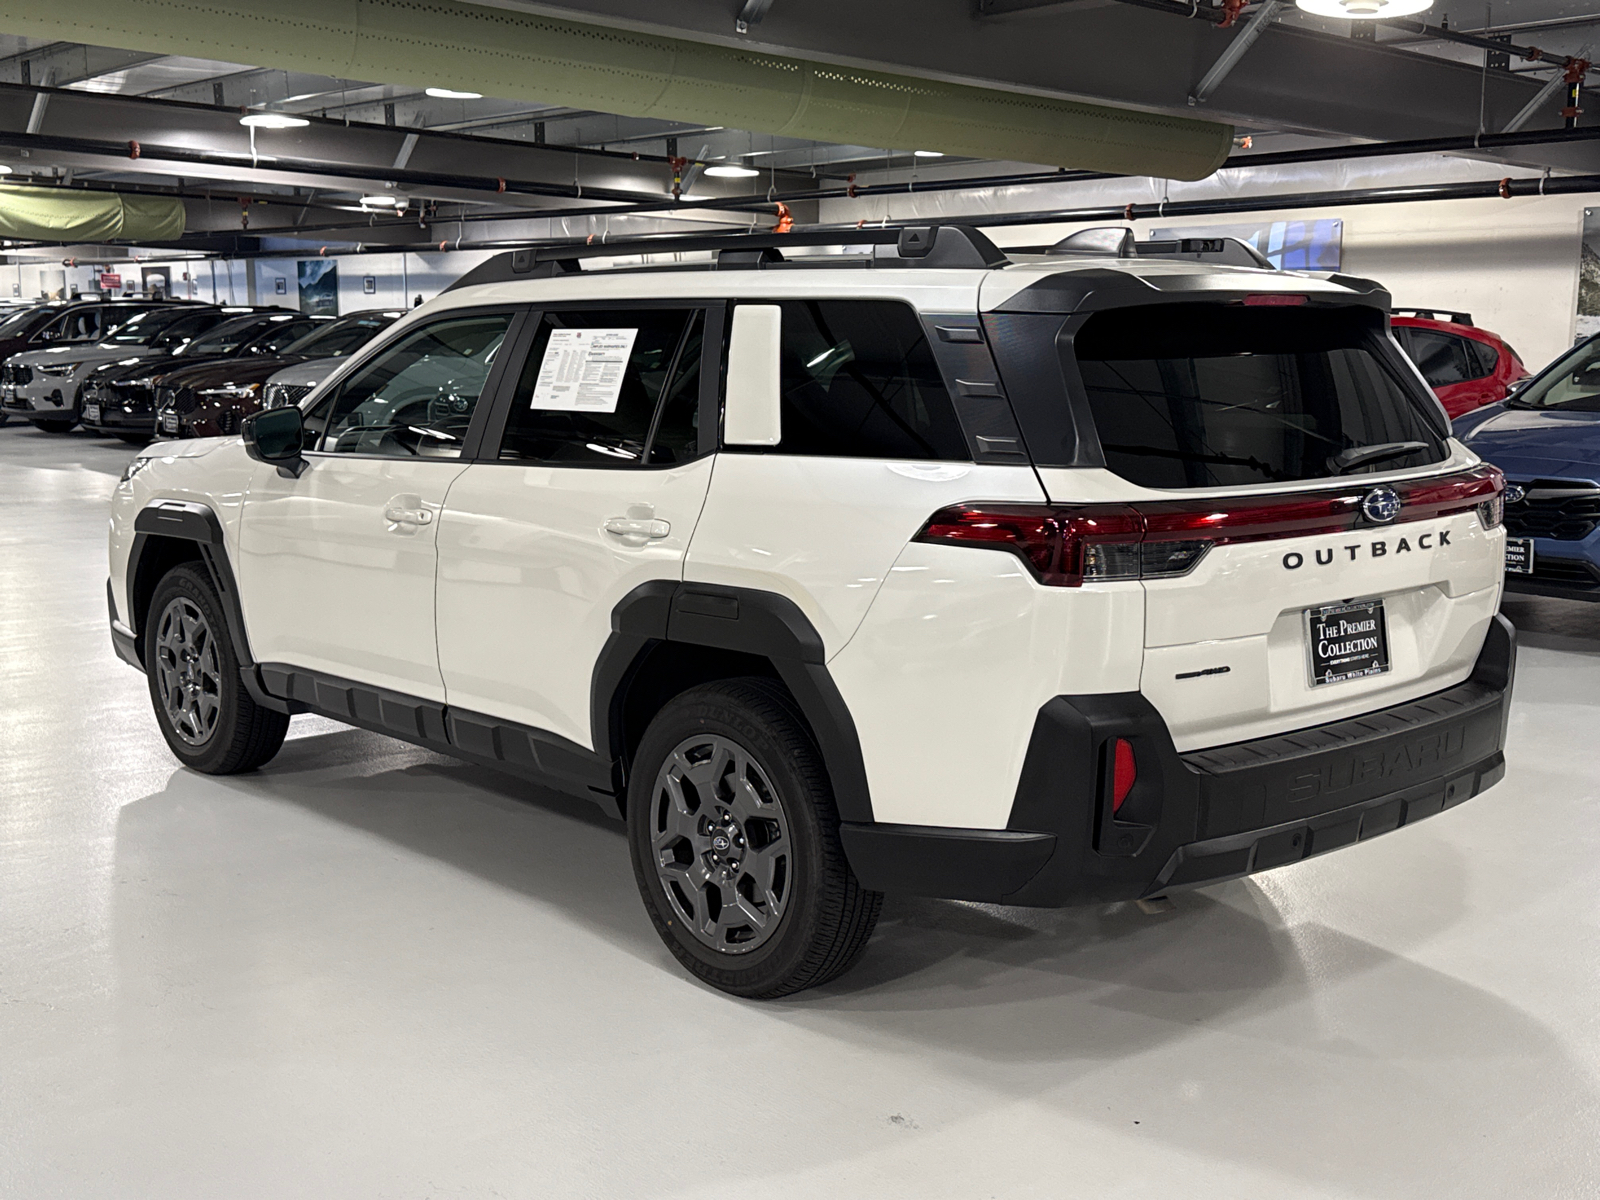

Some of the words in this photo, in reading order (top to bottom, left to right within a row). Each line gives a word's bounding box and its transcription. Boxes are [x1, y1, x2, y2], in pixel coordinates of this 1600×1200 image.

[1282, 530, 1452, 570] OUTBACK
[1317, 623, 1339, 640] THE
[1339, 620, 1376, 636] PREMIER
[1318, 637, 1377, 658] COLLECTION
[1325, 674, 1346, 683] Subaru
[1347, 671, 1363, 679] White
[1364, 667, 1381, 676] Plains
[697, 705, 770, 750] DUNLOP
[1286, 725, 1465, 803] SUBARU
